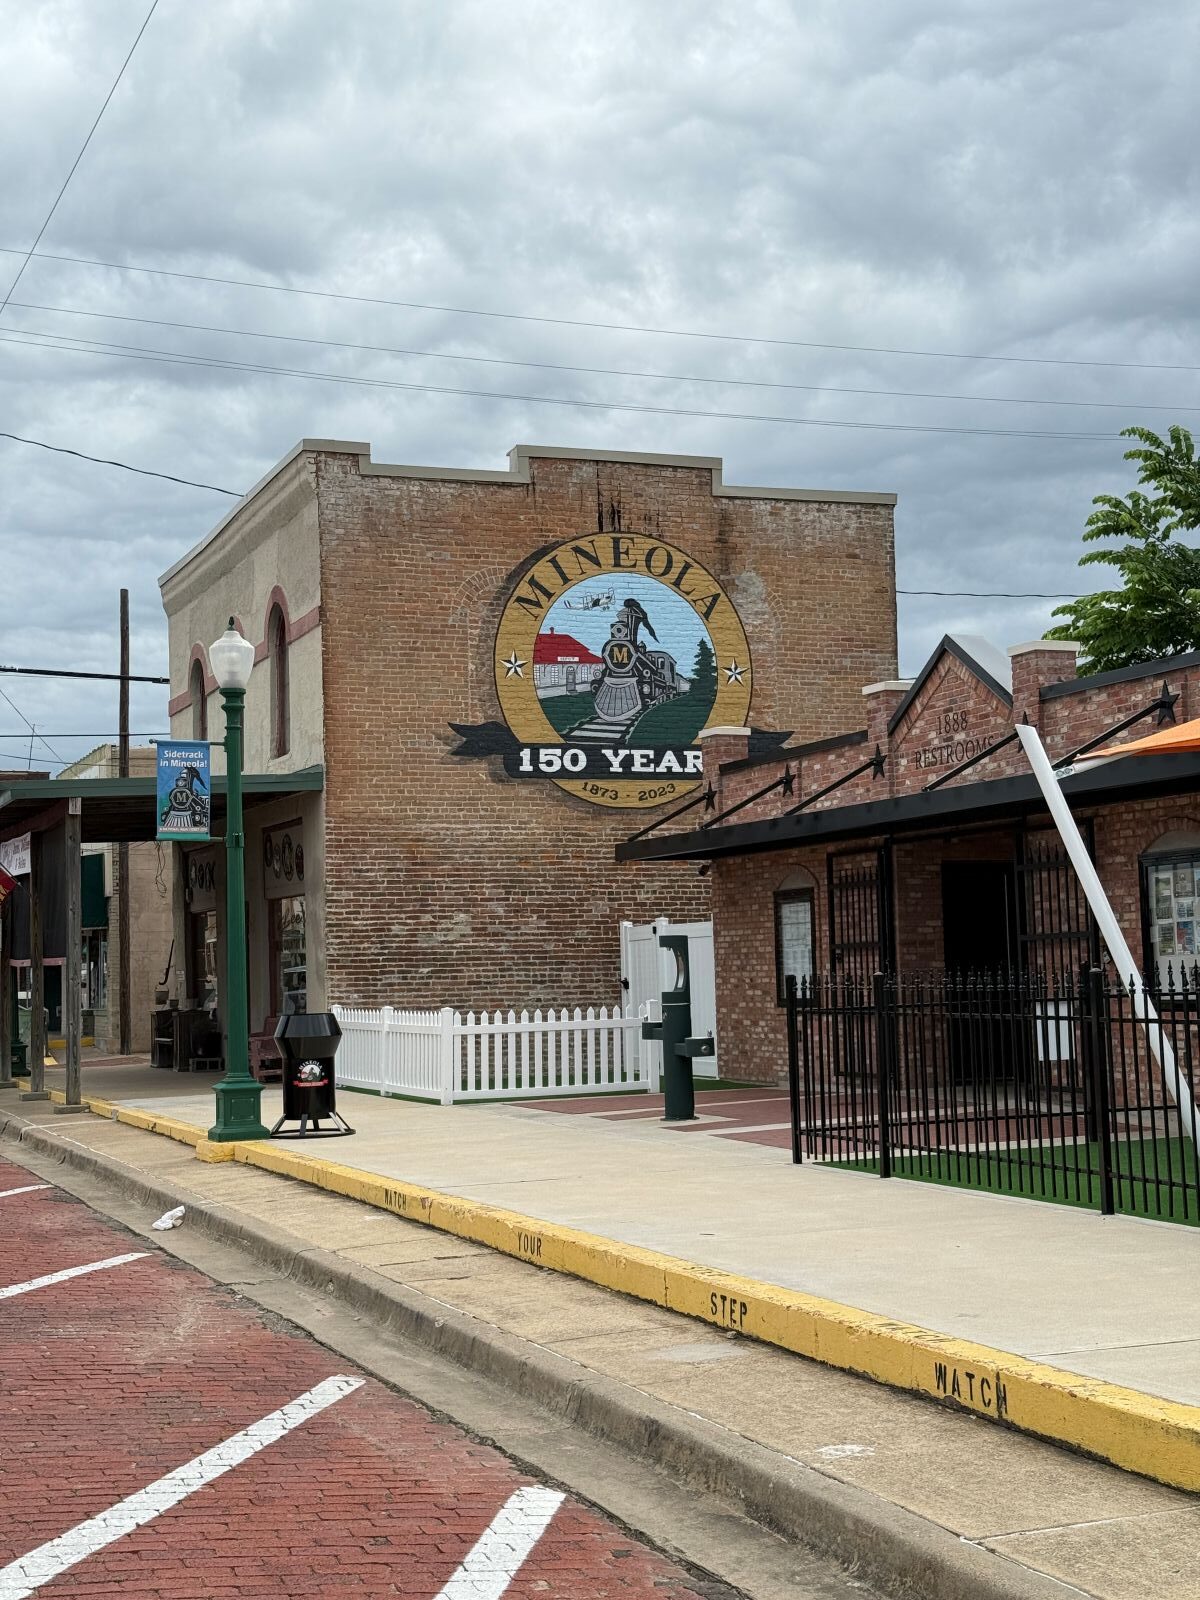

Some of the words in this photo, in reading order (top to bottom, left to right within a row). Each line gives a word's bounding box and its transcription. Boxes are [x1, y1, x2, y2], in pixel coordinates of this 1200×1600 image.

[514, 536, 723, 622] MINEOLA
[612, 646, 629, 664] M
[937, 711, 968, 735] 1888
[160, 759, 169, 767] in
[170, 759, 208, 768] Mineola!
[163, 750, 204, 759] Sidetrack
[519, 749, 587, 773] 150
[915, 736, 994, 770] RESTROOMS
[176, 792, 187, 803] M
[581, 782, 619, 801] 1873
[638, 783, 677, 802] 2023
[517, 1231, 543, 1258] YOUR
[710, 1291, 748, 1328] STEP
[934, 1362, 1009, 1415] WATCH
